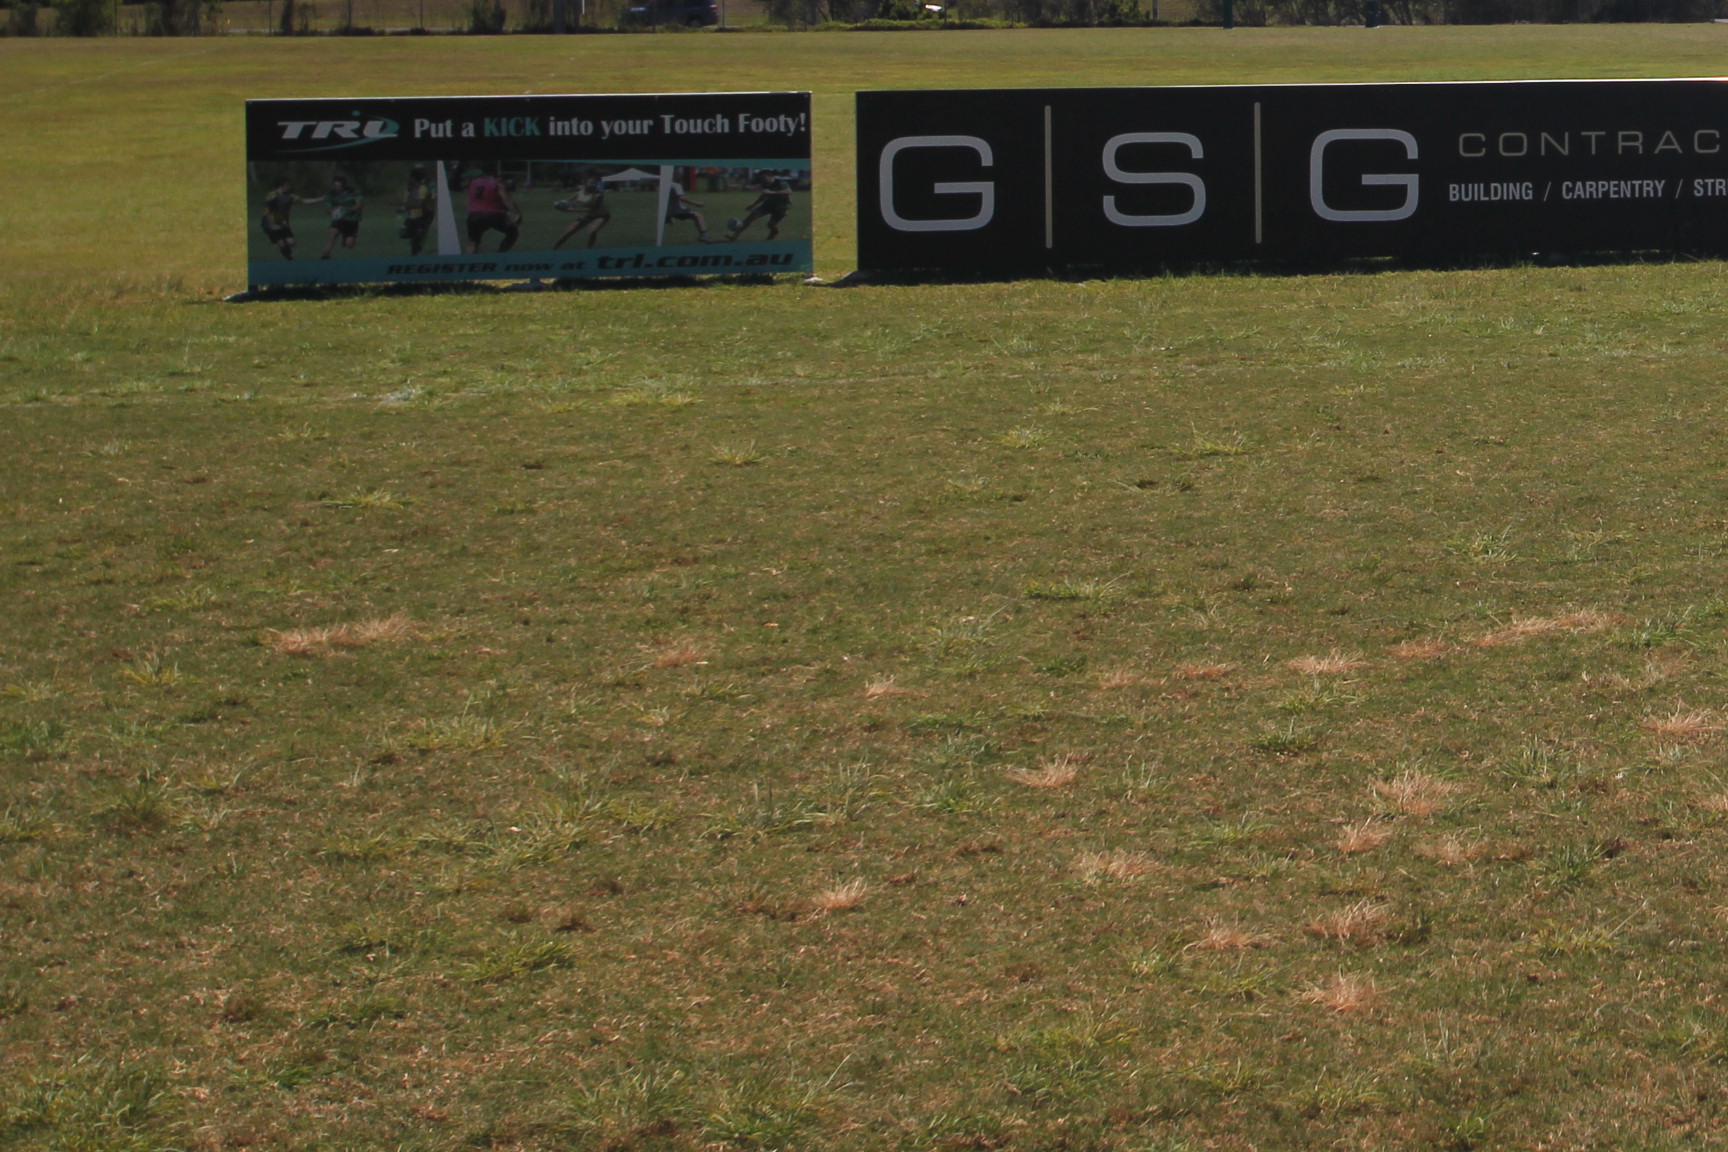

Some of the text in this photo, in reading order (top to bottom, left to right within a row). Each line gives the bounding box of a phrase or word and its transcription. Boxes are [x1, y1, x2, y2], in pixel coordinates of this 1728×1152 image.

[413, 113, 806, 139] Put a KICK into your Touch Footy!
[1448, 181, 1533, 202] BUILDING
[1562, 179, 1665, 200] CARPENTRY
[387, 252, 795, 275] REGISTER now at trl.com.au
